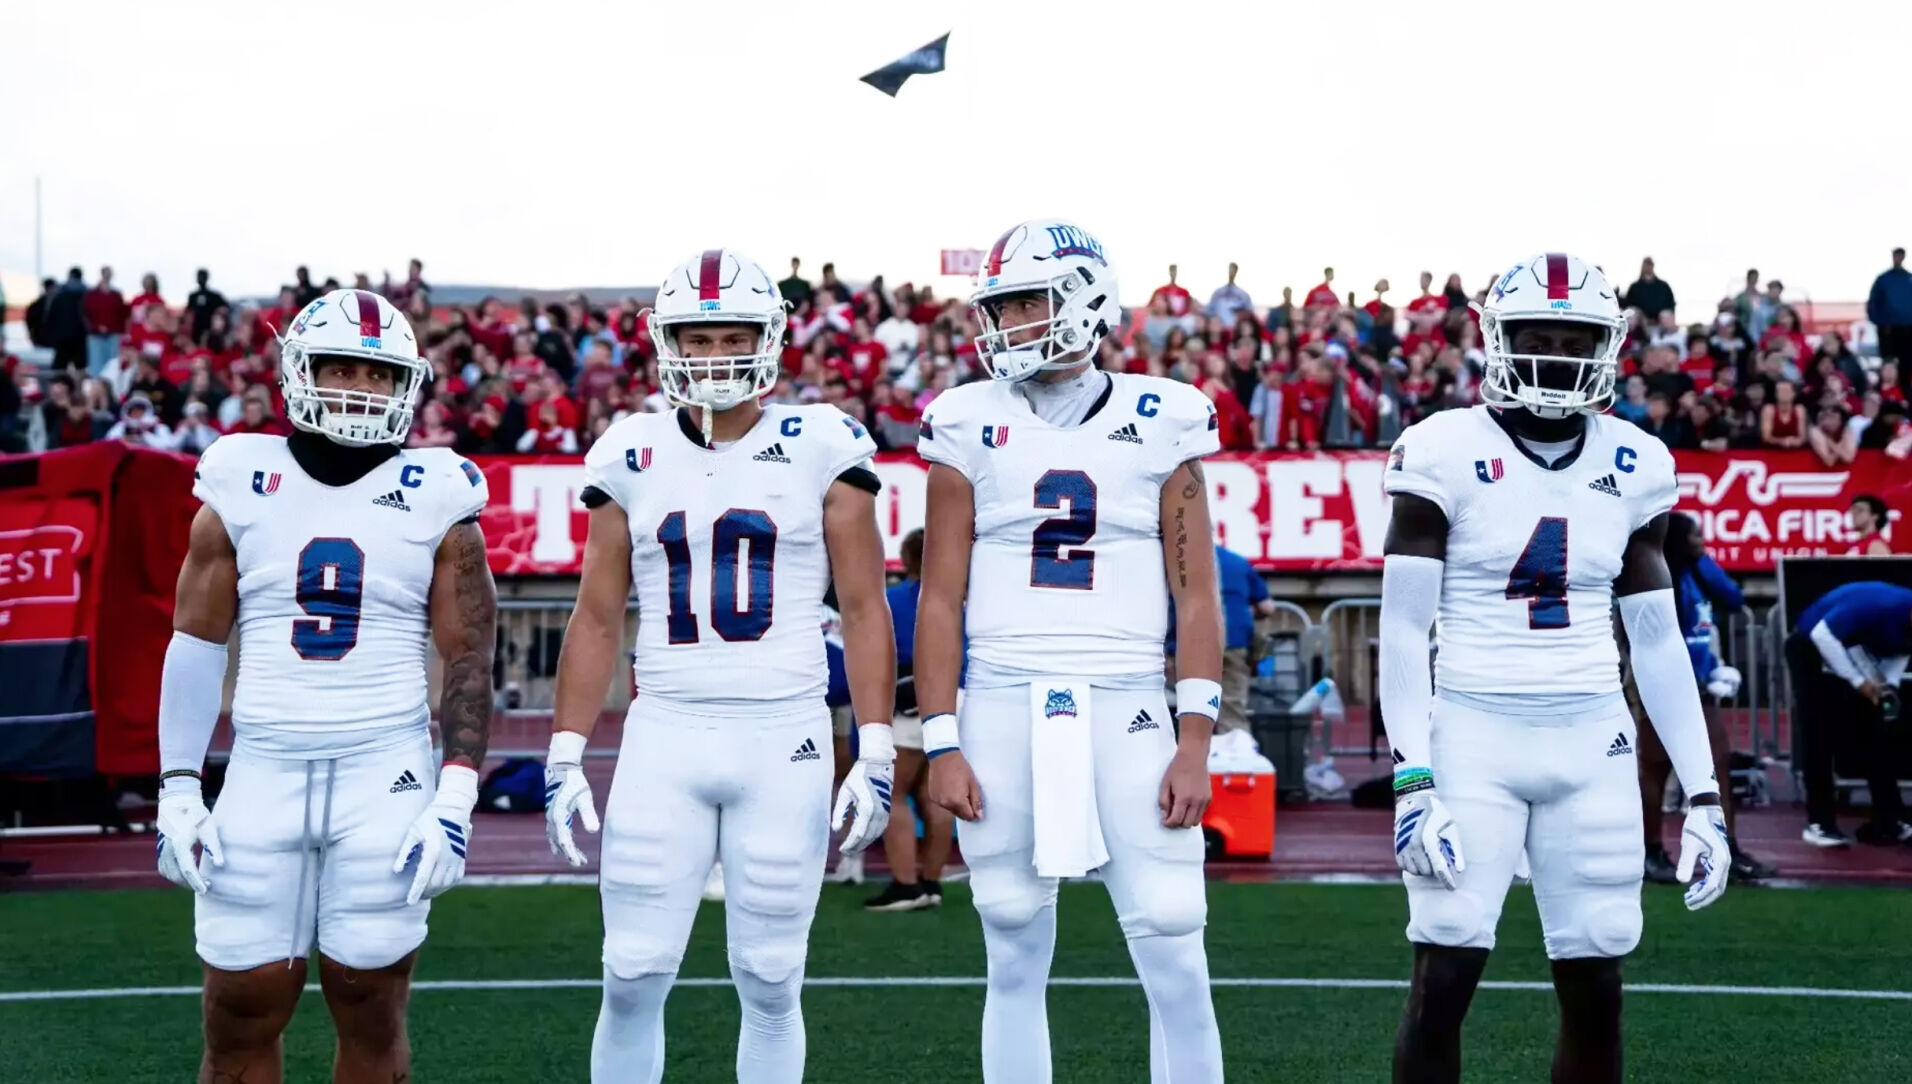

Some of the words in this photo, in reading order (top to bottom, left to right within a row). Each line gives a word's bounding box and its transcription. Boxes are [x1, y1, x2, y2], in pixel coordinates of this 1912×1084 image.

[1136, 393, 1161, 418] C
[780, 416, 802, 437] C
[1107, 432, 1143, 445] adidas
[753, 453, 791, 464] adidas
[1614, 446, 1638, 473] C
[399, 464, 425, 488] C
[1588, 481, 1622, 498] adidas
[372, 498, 411, 512] adidas
[1030, 469, 1097, 590] 2
[657, 508, 777, 645] 10
[1505, 516, 1571, 630] 4
[291, 537, 365, 661] 9
[1127, 722, 1159, 734] adidas
[790, 752, 821, 762] adidas
[1606, 746, 1632, 757] adidas
[390, 783, 422, 793] adidas
